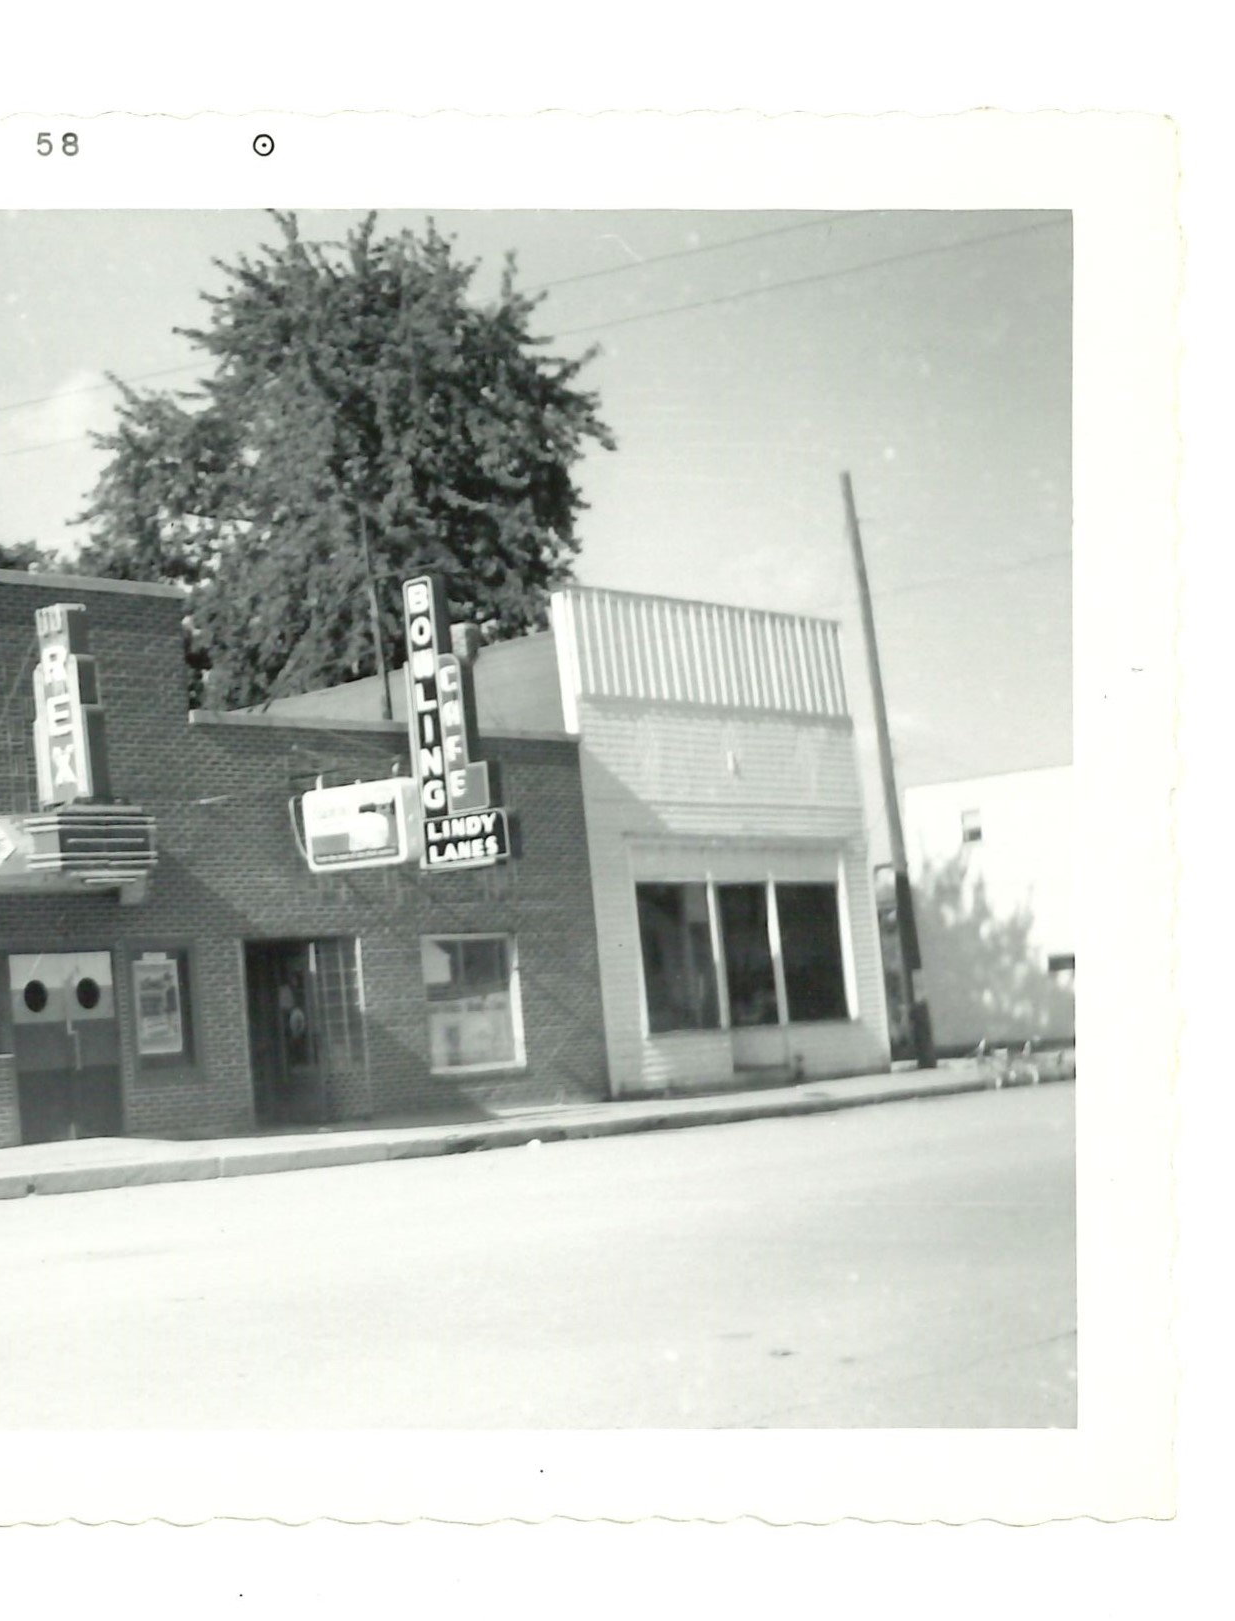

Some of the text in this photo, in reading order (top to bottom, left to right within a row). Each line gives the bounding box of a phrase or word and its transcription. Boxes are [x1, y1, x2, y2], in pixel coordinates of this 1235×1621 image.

[41, 645, 78, 786] REX
[406, 583, 446, 809] BOWLING
[438, 664, 467, 798] CAFE
[426, 811, 496, 841] LINDY
[428, 835, 499, 863] LANES
